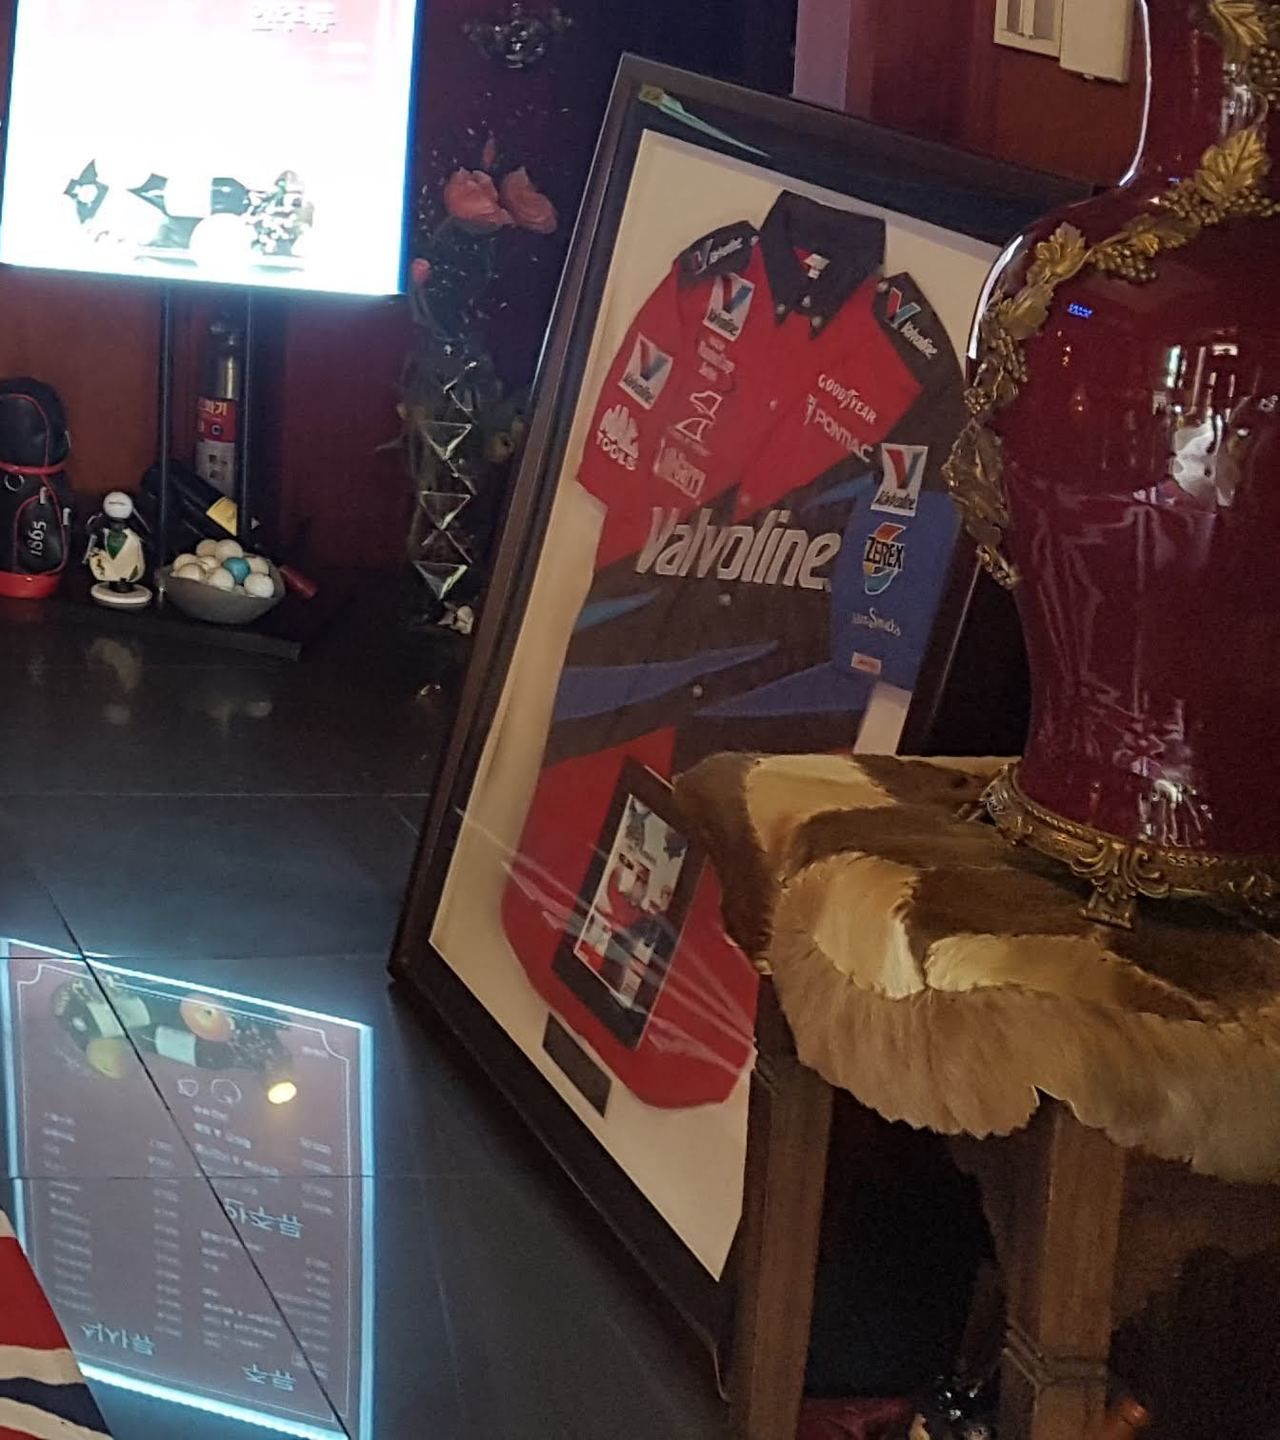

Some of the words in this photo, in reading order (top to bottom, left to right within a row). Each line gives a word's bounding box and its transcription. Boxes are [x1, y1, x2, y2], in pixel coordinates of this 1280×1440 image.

[817, 373, 878, 424] GOODYEAR
[595, 430, 637, 471] TOOLS
[813, 410, 874, 463] PONTIAC
[28, 521, 47, 557] 1865
[634, 507, 842, 591] Valvoline
[866, 536, 906, 570] ZEREX
